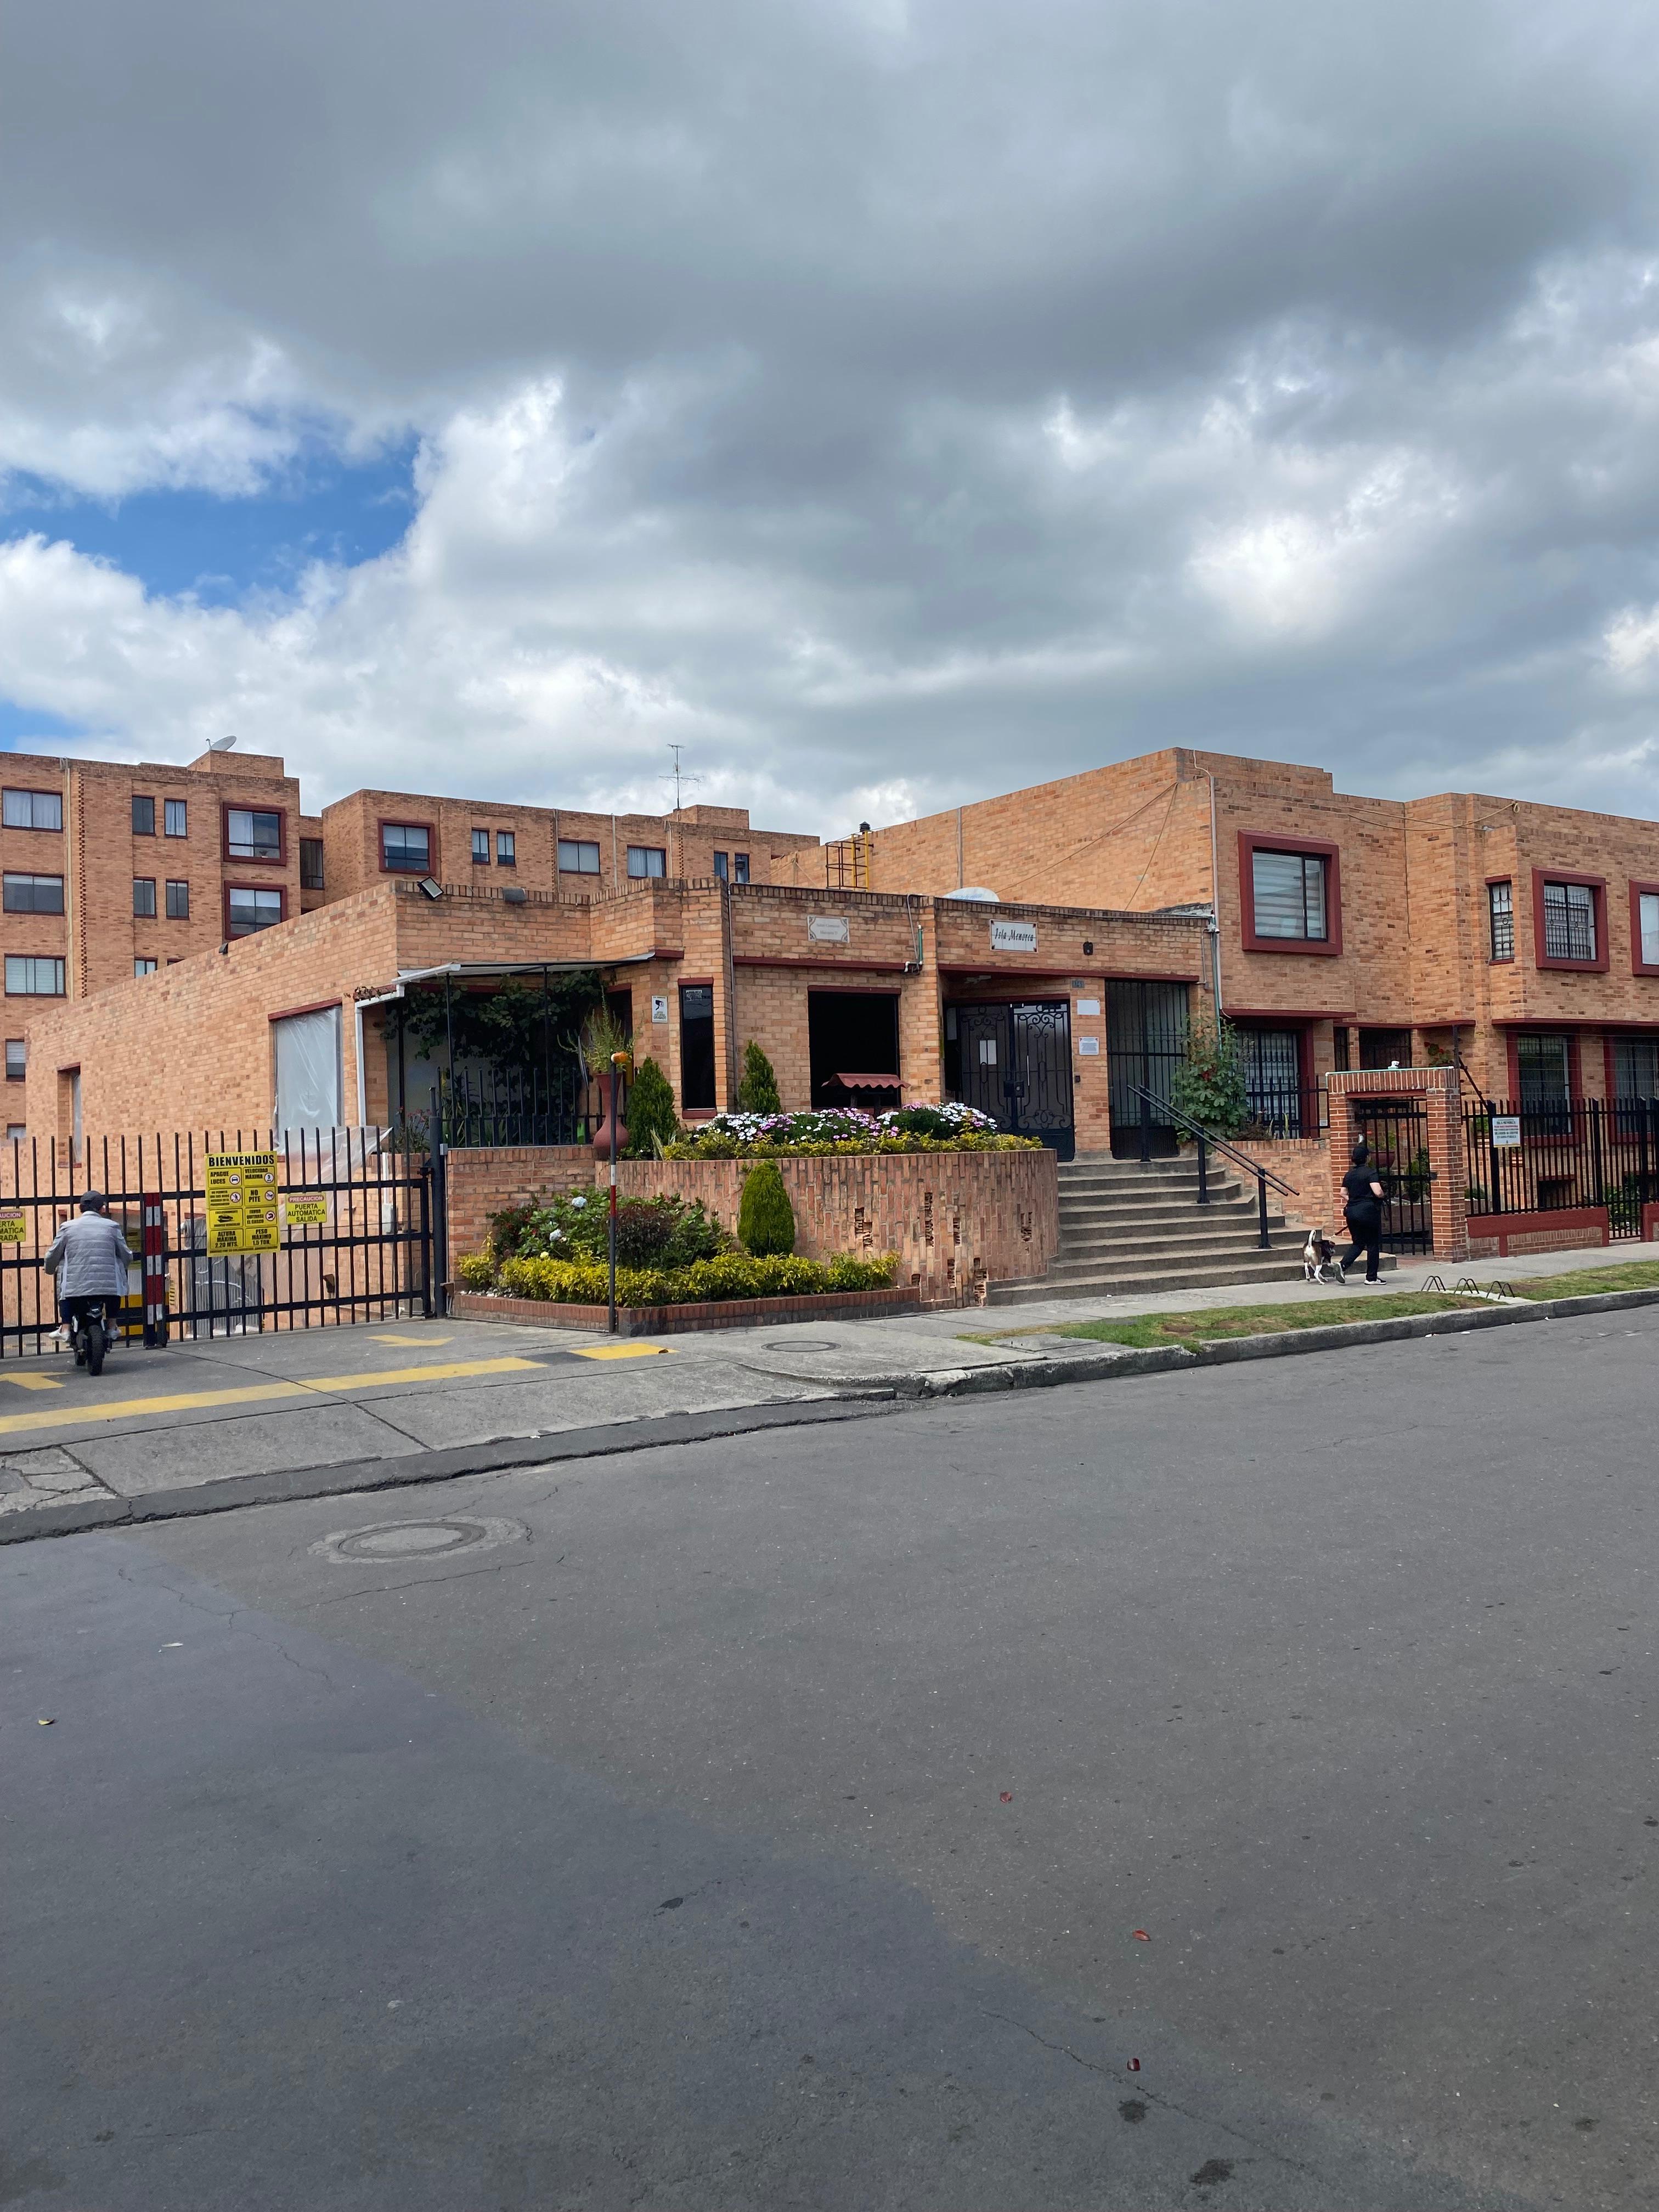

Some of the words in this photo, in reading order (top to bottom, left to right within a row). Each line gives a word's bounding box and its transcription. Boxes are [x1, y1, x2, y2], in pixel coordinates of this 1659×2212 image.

[995, 928, 1006, 940] Isla
[1008, 929, 1034, 941] Menorca
[208, 1155, 274, 1166] BIENVENIDOS
